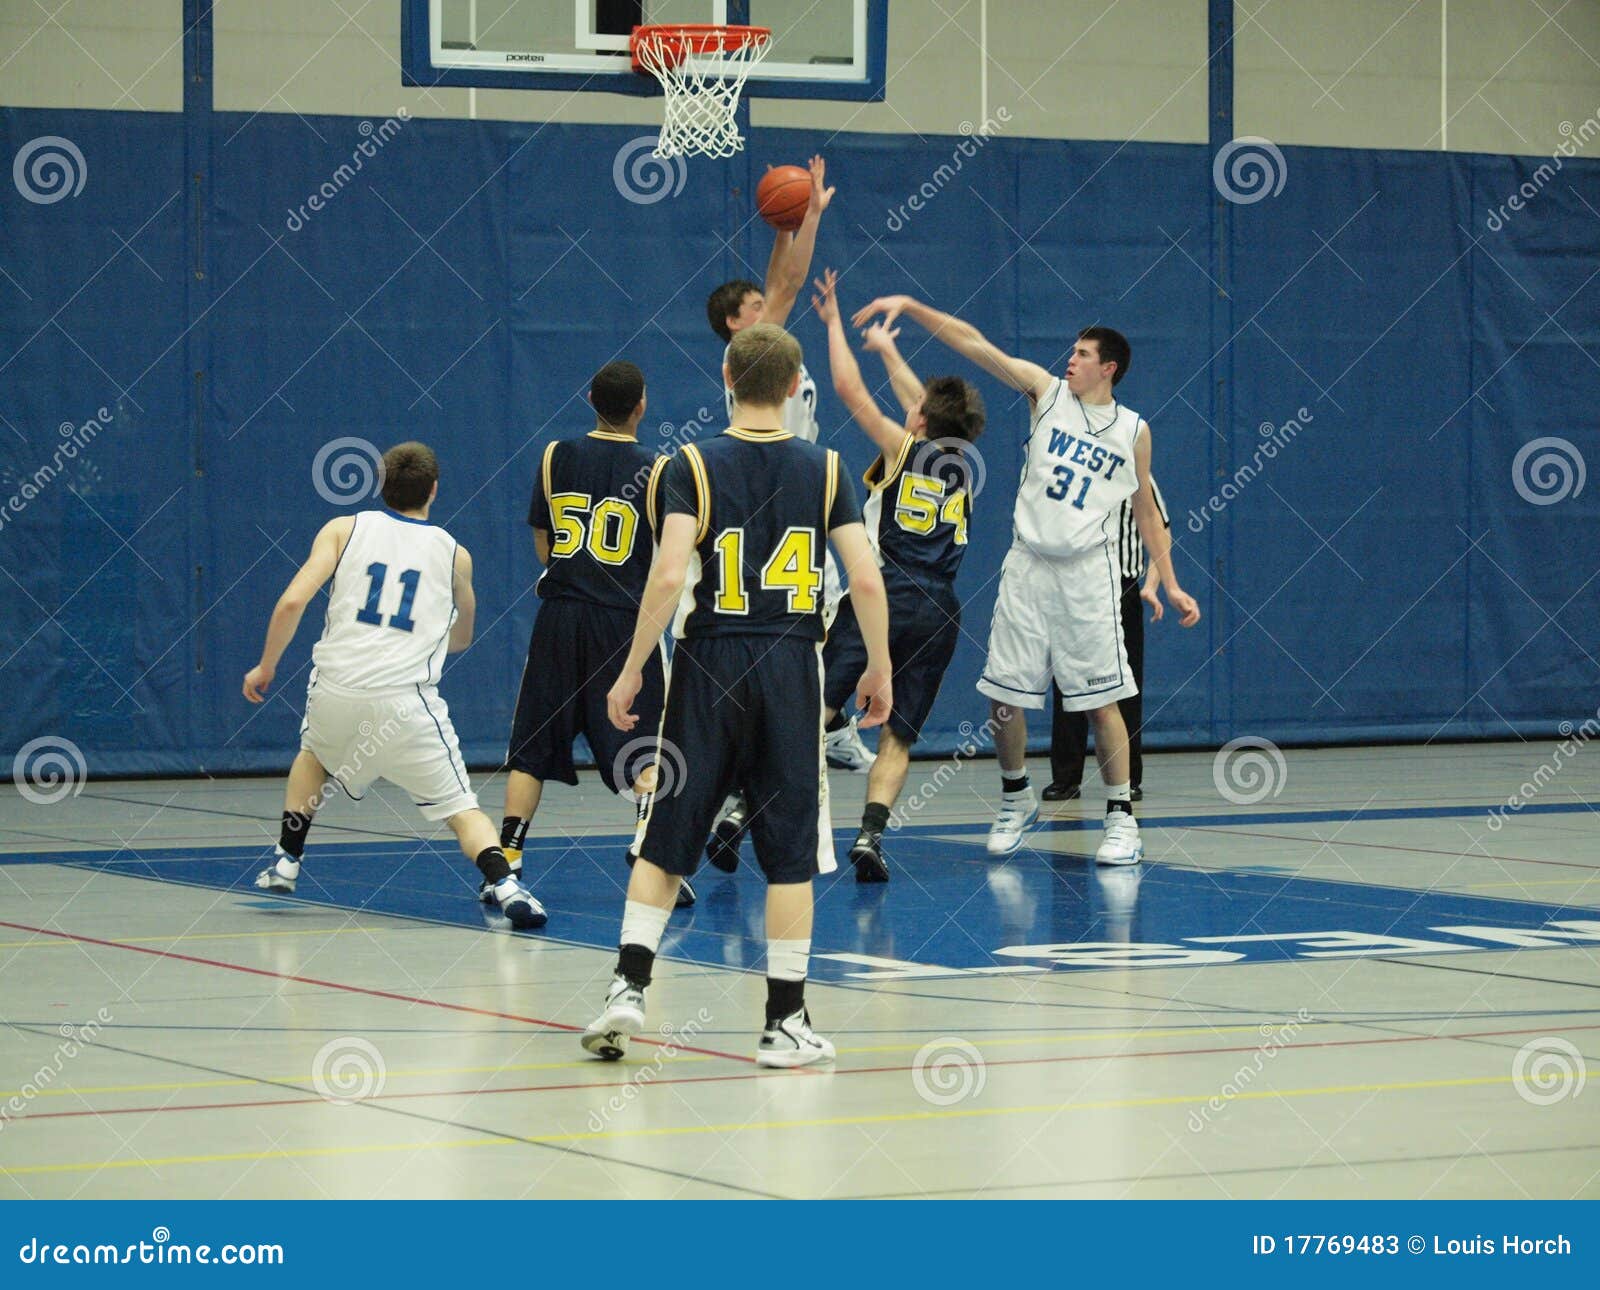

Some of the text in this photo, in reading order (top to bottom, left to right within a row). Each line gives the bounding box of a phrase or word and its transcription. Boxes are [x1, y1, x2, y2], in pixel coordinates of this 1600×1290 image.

[1046, 465, 1094, 511] 31
[1048, 428, 1126, 481] WEST
[550, 492, 640, 566] 50
[895, 471, 968, 545] 54
[356, 562, 421, 633] 11
[714, 526, 823, 616] 14
